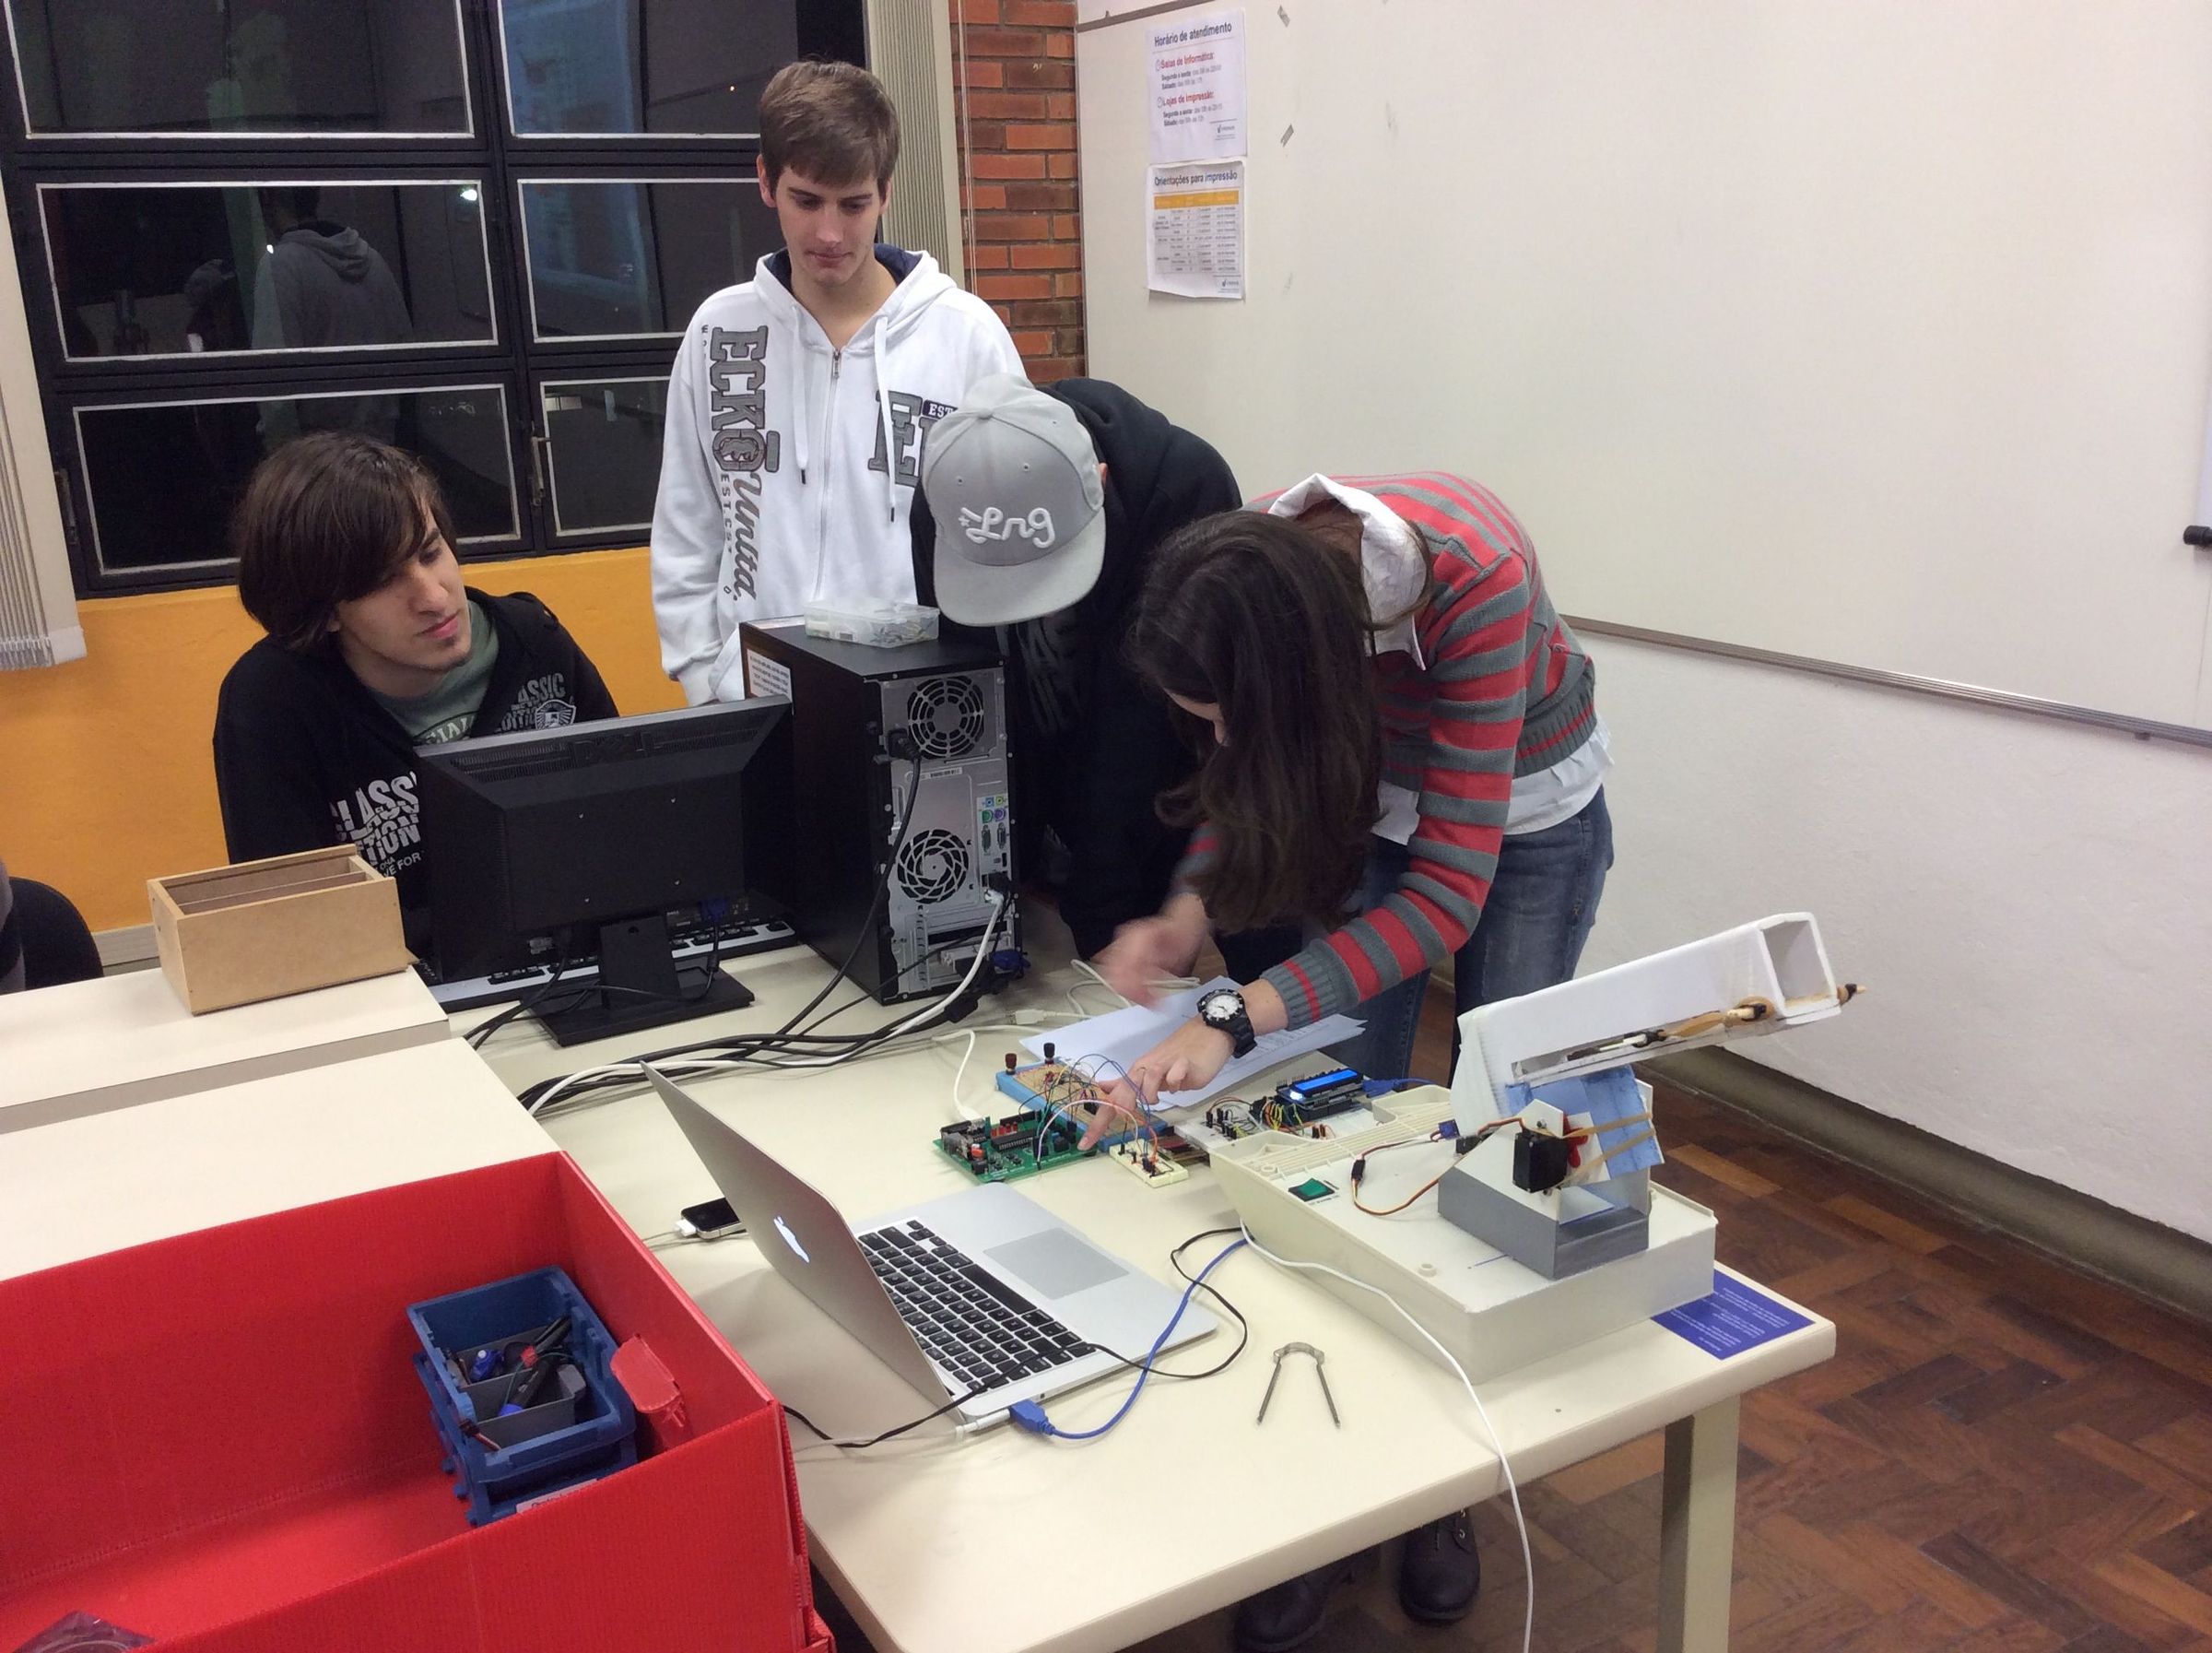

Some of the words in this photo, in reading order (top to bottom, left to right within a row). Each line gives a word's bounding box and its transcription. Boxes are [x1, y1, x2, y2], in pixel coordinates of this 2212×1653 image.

[1154, 32, 1179, 47] Horário
[1180, 30, 1187, 41] de
[1189, 22, 1232, 40] atendimento
[1154, 172, 1190, 187] Orientações
[1190, 172, 1205, 185] para
[1205, 170, 1238, 183] impressão
[517, 672, 567, 704] ASSIC
[331, 771, 420, 842] LASS
[396, 850, 422, 871] FOR
